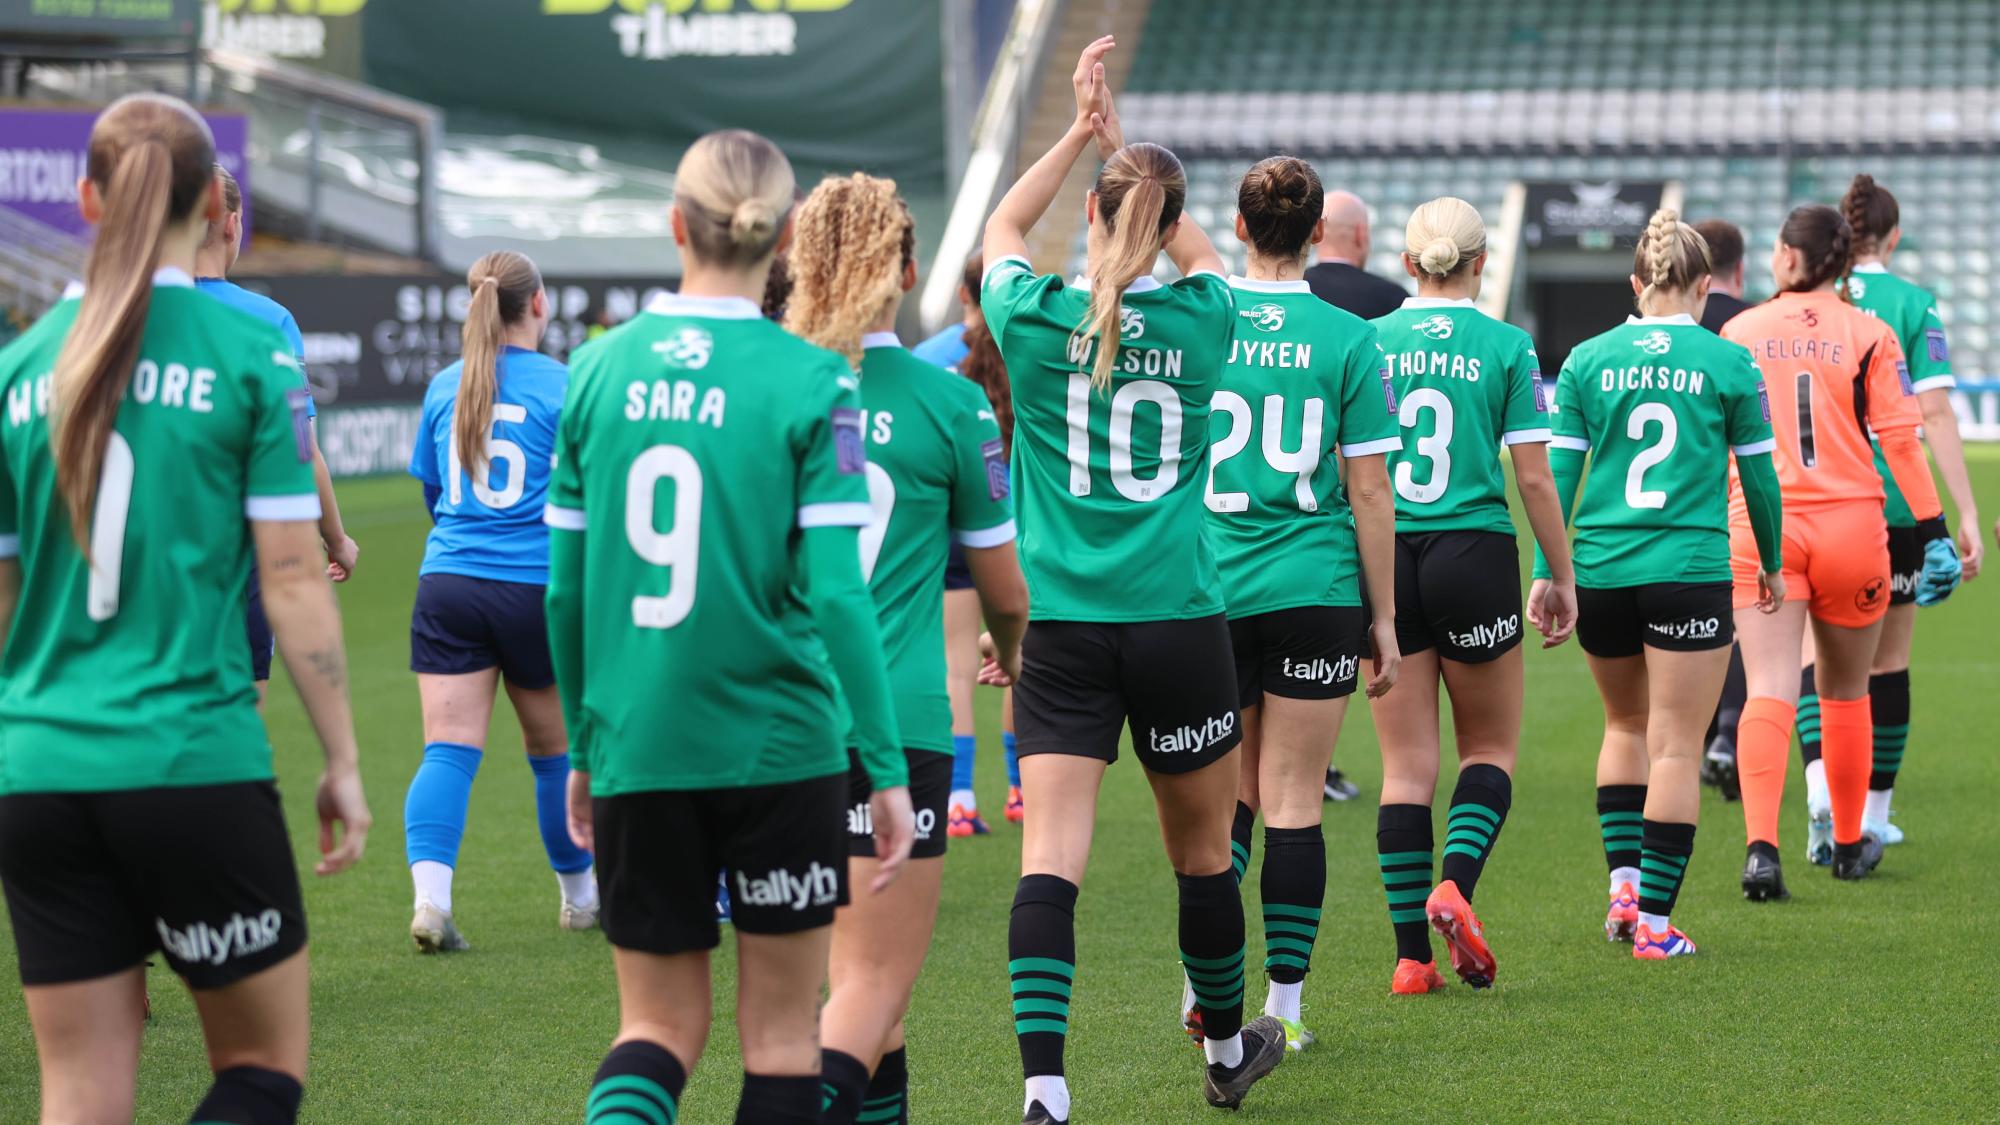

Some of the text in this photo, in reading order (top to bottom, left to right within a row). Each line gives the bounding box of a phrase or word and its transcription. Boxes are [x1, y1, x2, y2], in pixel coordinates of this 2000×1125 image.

[202, 4, 326, 57] IMBER
[610, 3, 798, 58] TIMBER
[1068, 335, 1183, 378] WSON
[1384, 350, 1480, 382] THOMAS
[1754, 339, 1843, 365] FELGATE
[8, 358, 216, 428] WHORE
[625, 380, 725, 428] SARA
[1601, 366, 1704, 395] DICKSON
[1066, 373, 1183, 503] 10
[1394, 387, 1454, 504] 3
[1794, 371, 1815, 470] 1
[1203, 390, 1325, 513] 24
[1625, 402, 1678, 509] 2
[625, 444, 703, 629] 9
[1448, 614, 1518, 648] tallyho
[1648, 617, 1719, 639] allyho
[1282, 654, 1358, 685] tallyho
[1150, 711, 1235, 753] tallyho
[736, 861, 838, 911] tallyh
[156, 908, 282, 966] tallyho
